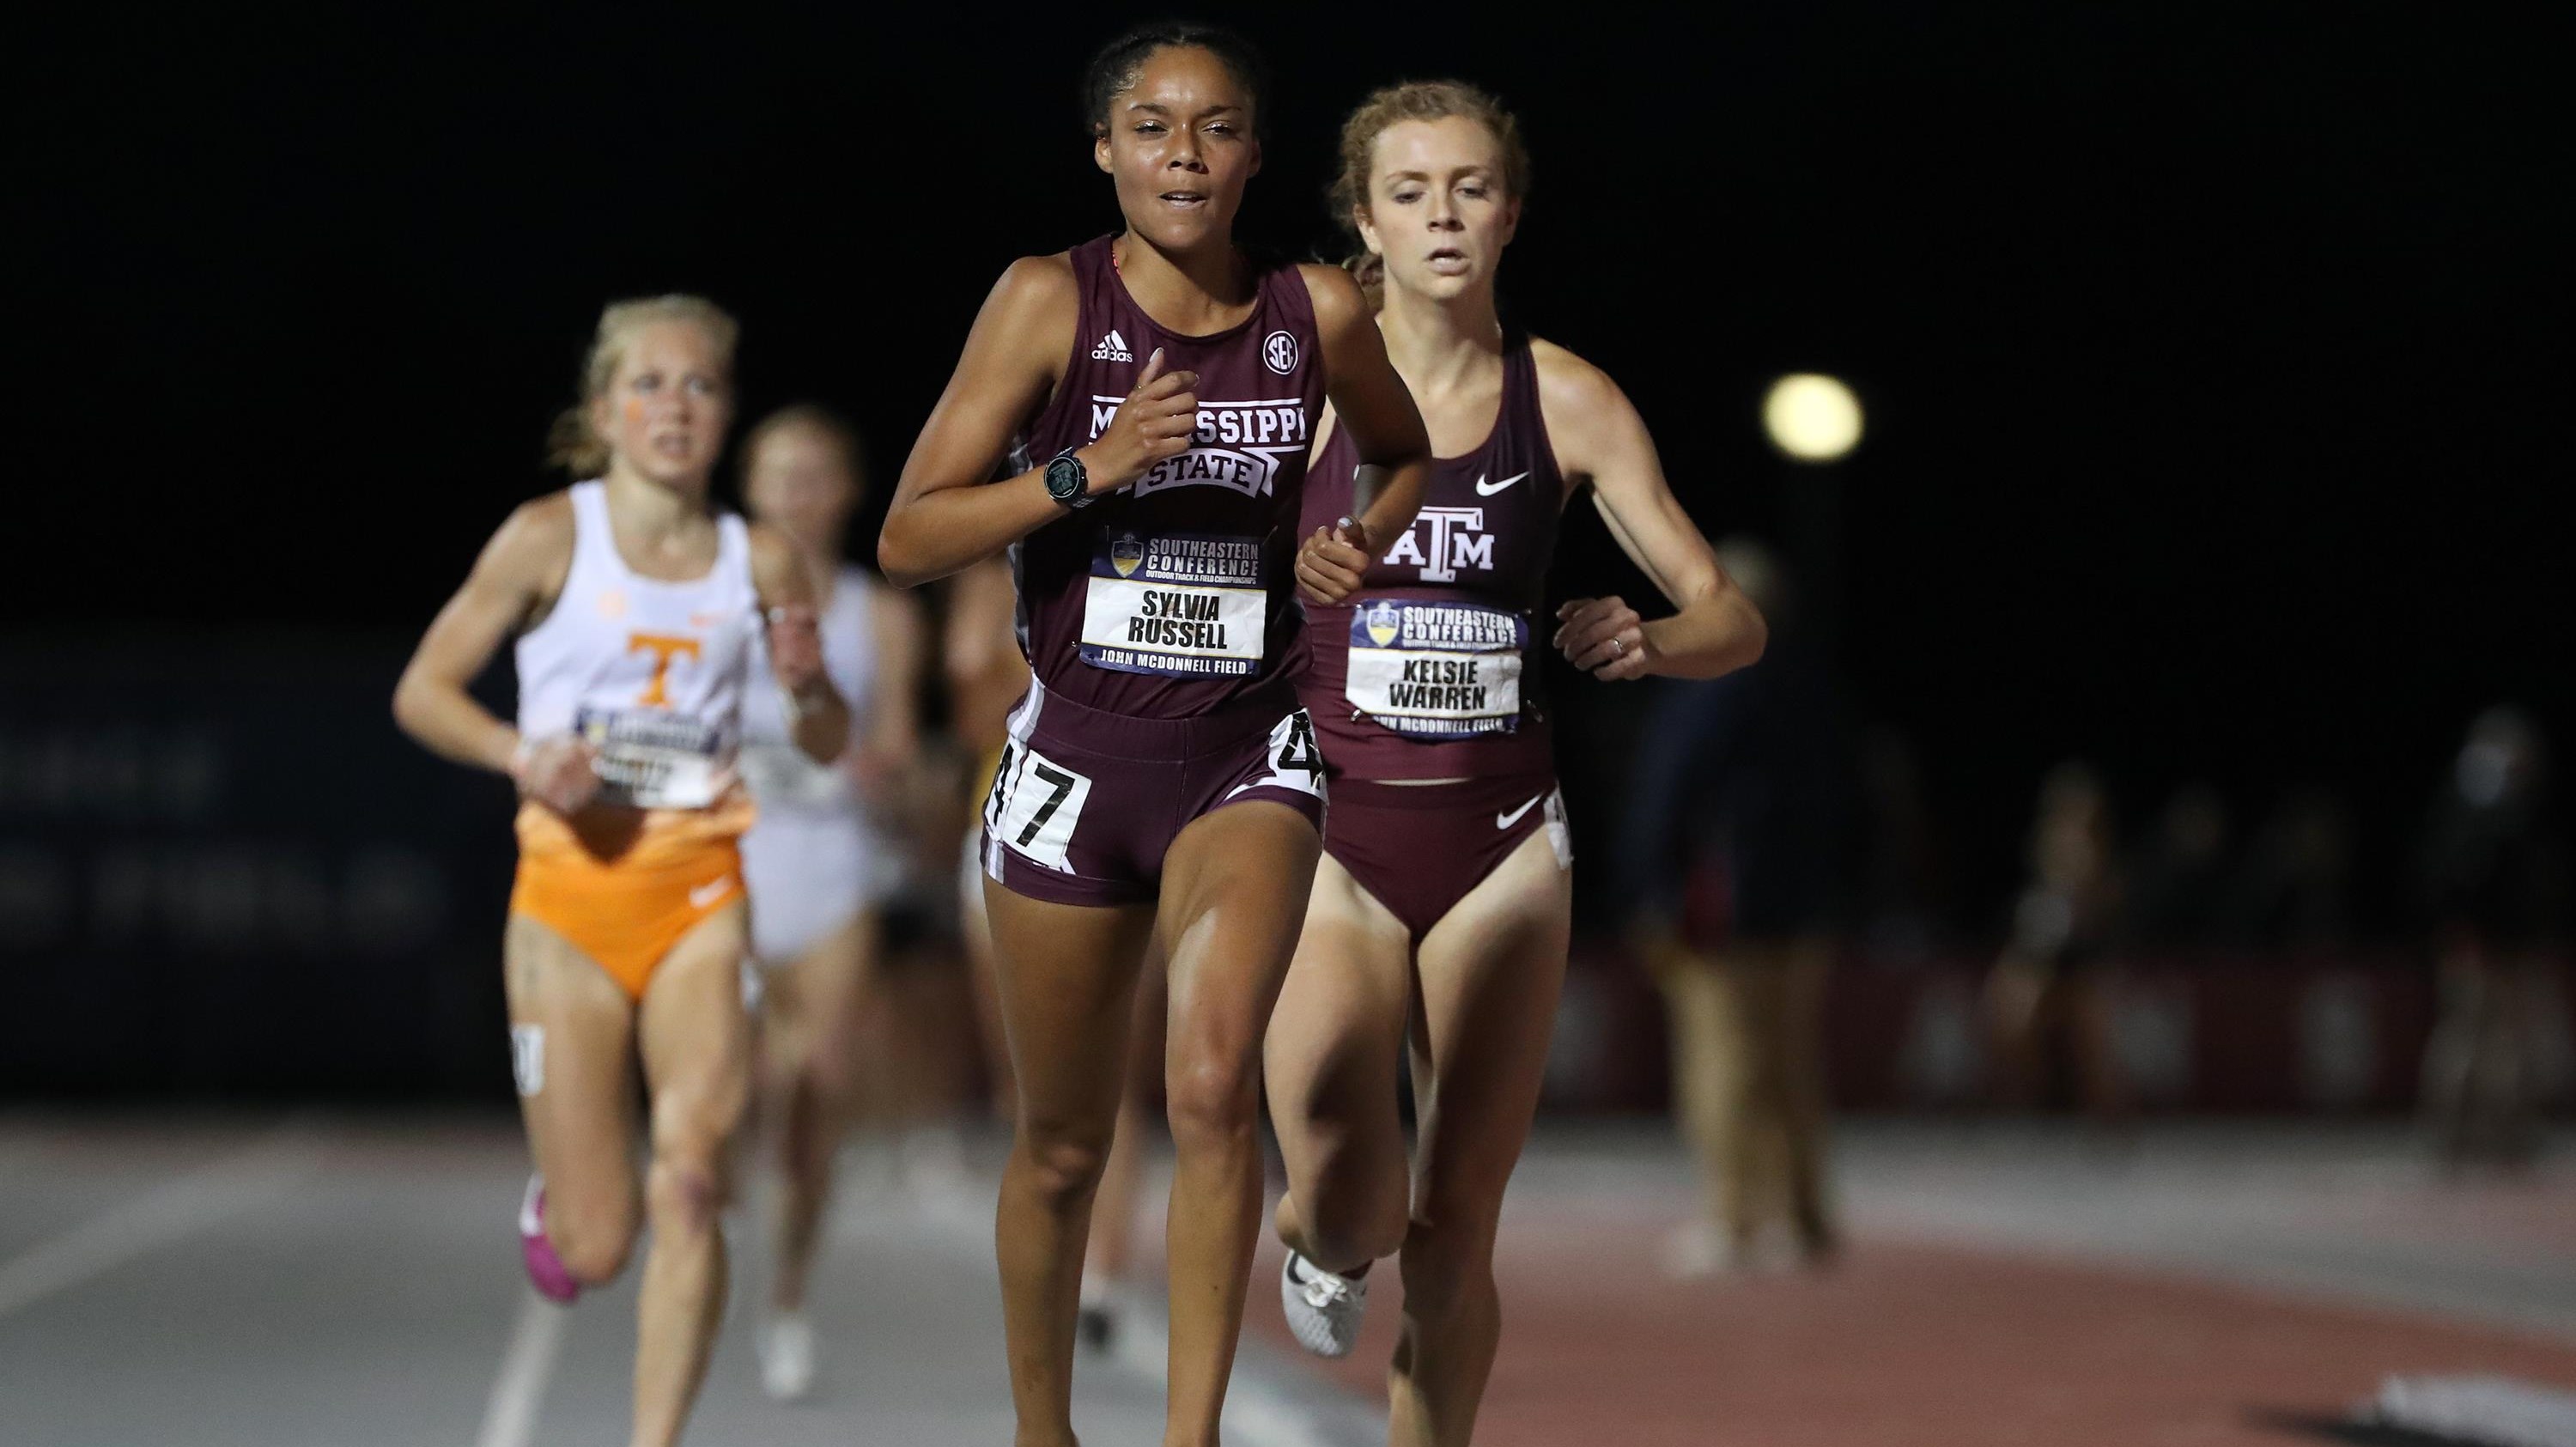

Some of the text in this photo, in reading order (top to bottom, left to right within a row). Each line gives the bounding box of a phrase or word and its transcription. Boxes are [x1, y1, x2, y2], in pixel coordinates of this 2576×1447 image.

[1091, 347, 1133, 362] adidas
[1268, 335, 1297, 370] SEC
[1089, 404, 1306, 443] MSSIPPI
[1147, 453, 1255, 488] STATE
[1149, 538, 1259, 560] SOUTHEASTERN
[1145, 569, 1175, 580] OUTDOOR
[1175, 573, 1194, 581] TRACK
[1200, 575, 1214, 583] FIELD
[1214, 575, 1256, 585] CHAMPIONSHIPS
[1146, 555, 1259, 576] CONFERENCE
[1141, 590, 1220, 621] SYLVIA
[1403, 606, 1516, 629] SOUTHEASTERN
[1127, 617, 1228, 649] RUSSELL
[1403, 623, 1516, 644] CONFERENCE
[628, 633, 702, 708] T
[1100, 649, 1247, 675] JOHN MCDONNELL FIELD
[1403, 660, 1478, 684] KELSIE
[1389, 684, 1486, 710] WARREN
[1400, 717, 1470, 733] MCDONNELL
